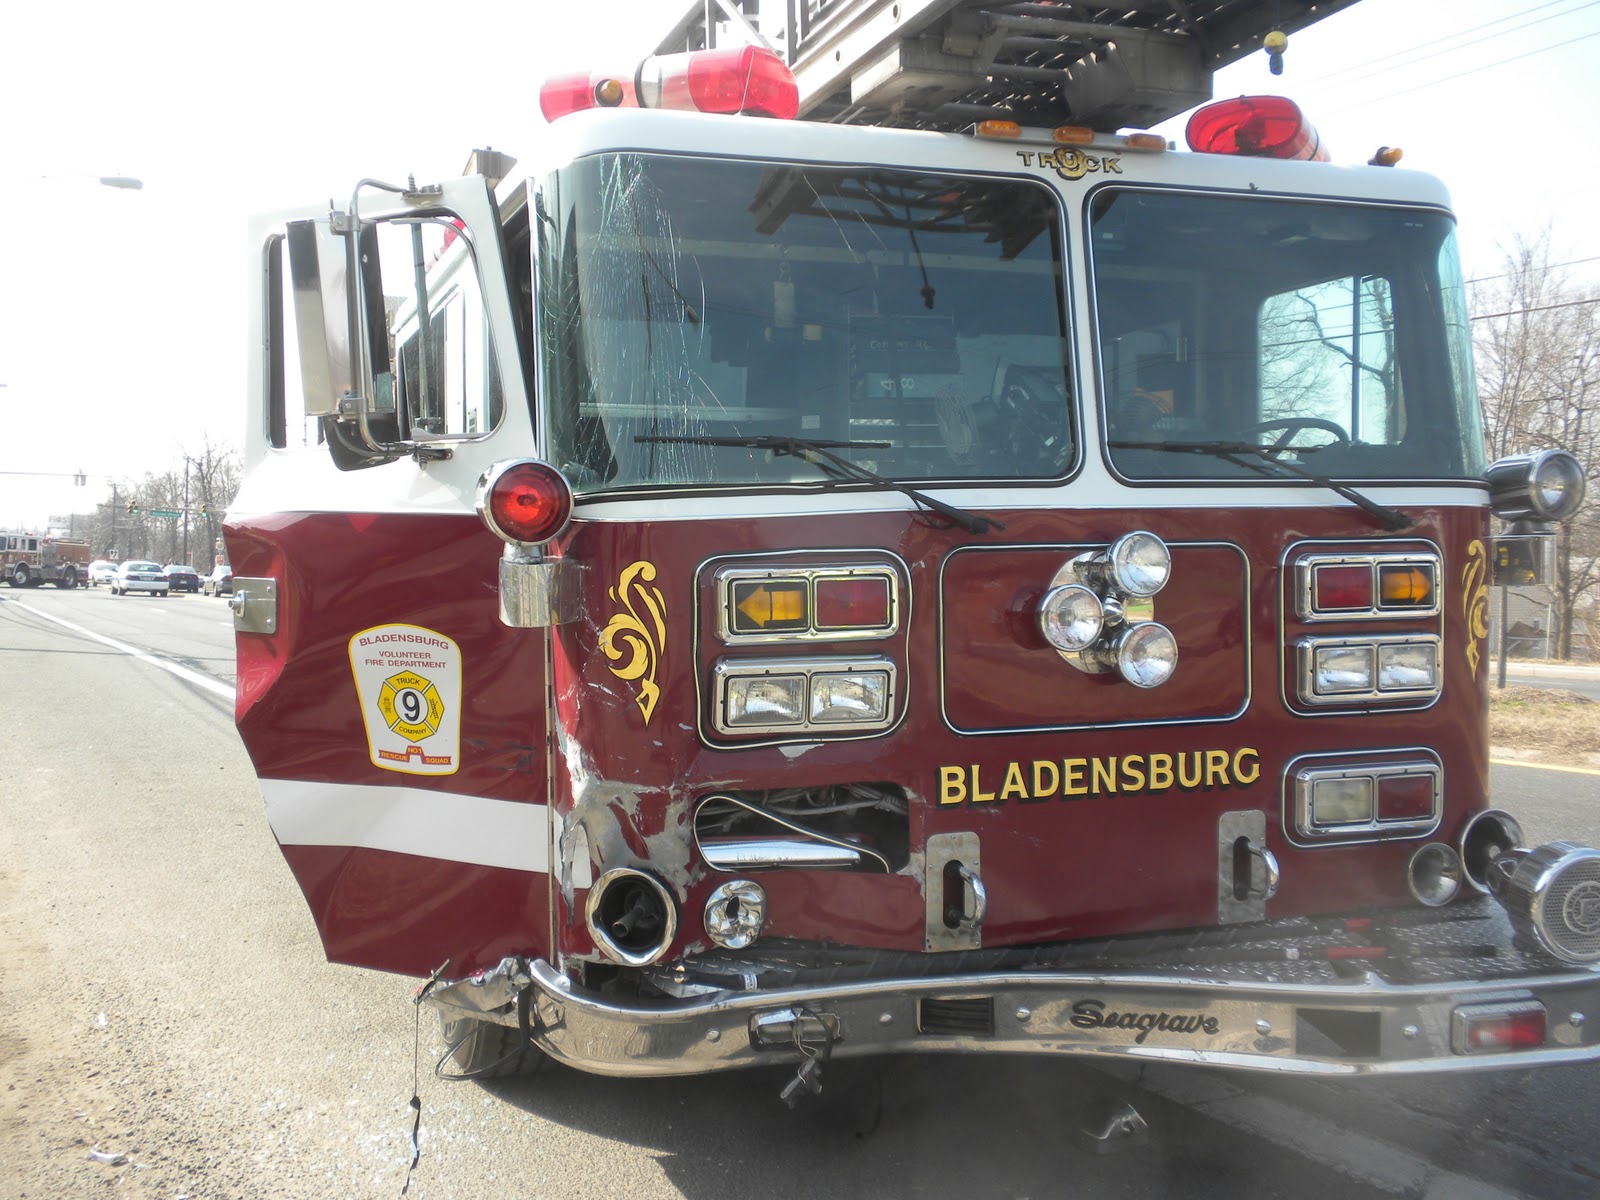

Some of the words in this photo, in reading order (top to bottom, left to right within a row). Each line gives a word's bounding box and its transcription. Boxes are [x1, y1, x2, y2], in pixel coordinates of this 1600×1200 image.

[1016, 151, 1123, 174] TRUCK
[359, 634, 449, 650] BLADENSBURG
[379, 651, 431, 659] VOLUNTEER
[388, 660, 446, 669] DEPARTMENT
[396, 678, 421, 686] TRUCK
[402, 691, 420, 722] 9
[398, 726, 427, 735] COMPANY
[380, 752, 409, 761] RESCUE
[938, 747, 1261, 806] BLADENSBURG
[1070, 999, 1220, 1044] Seagrave
